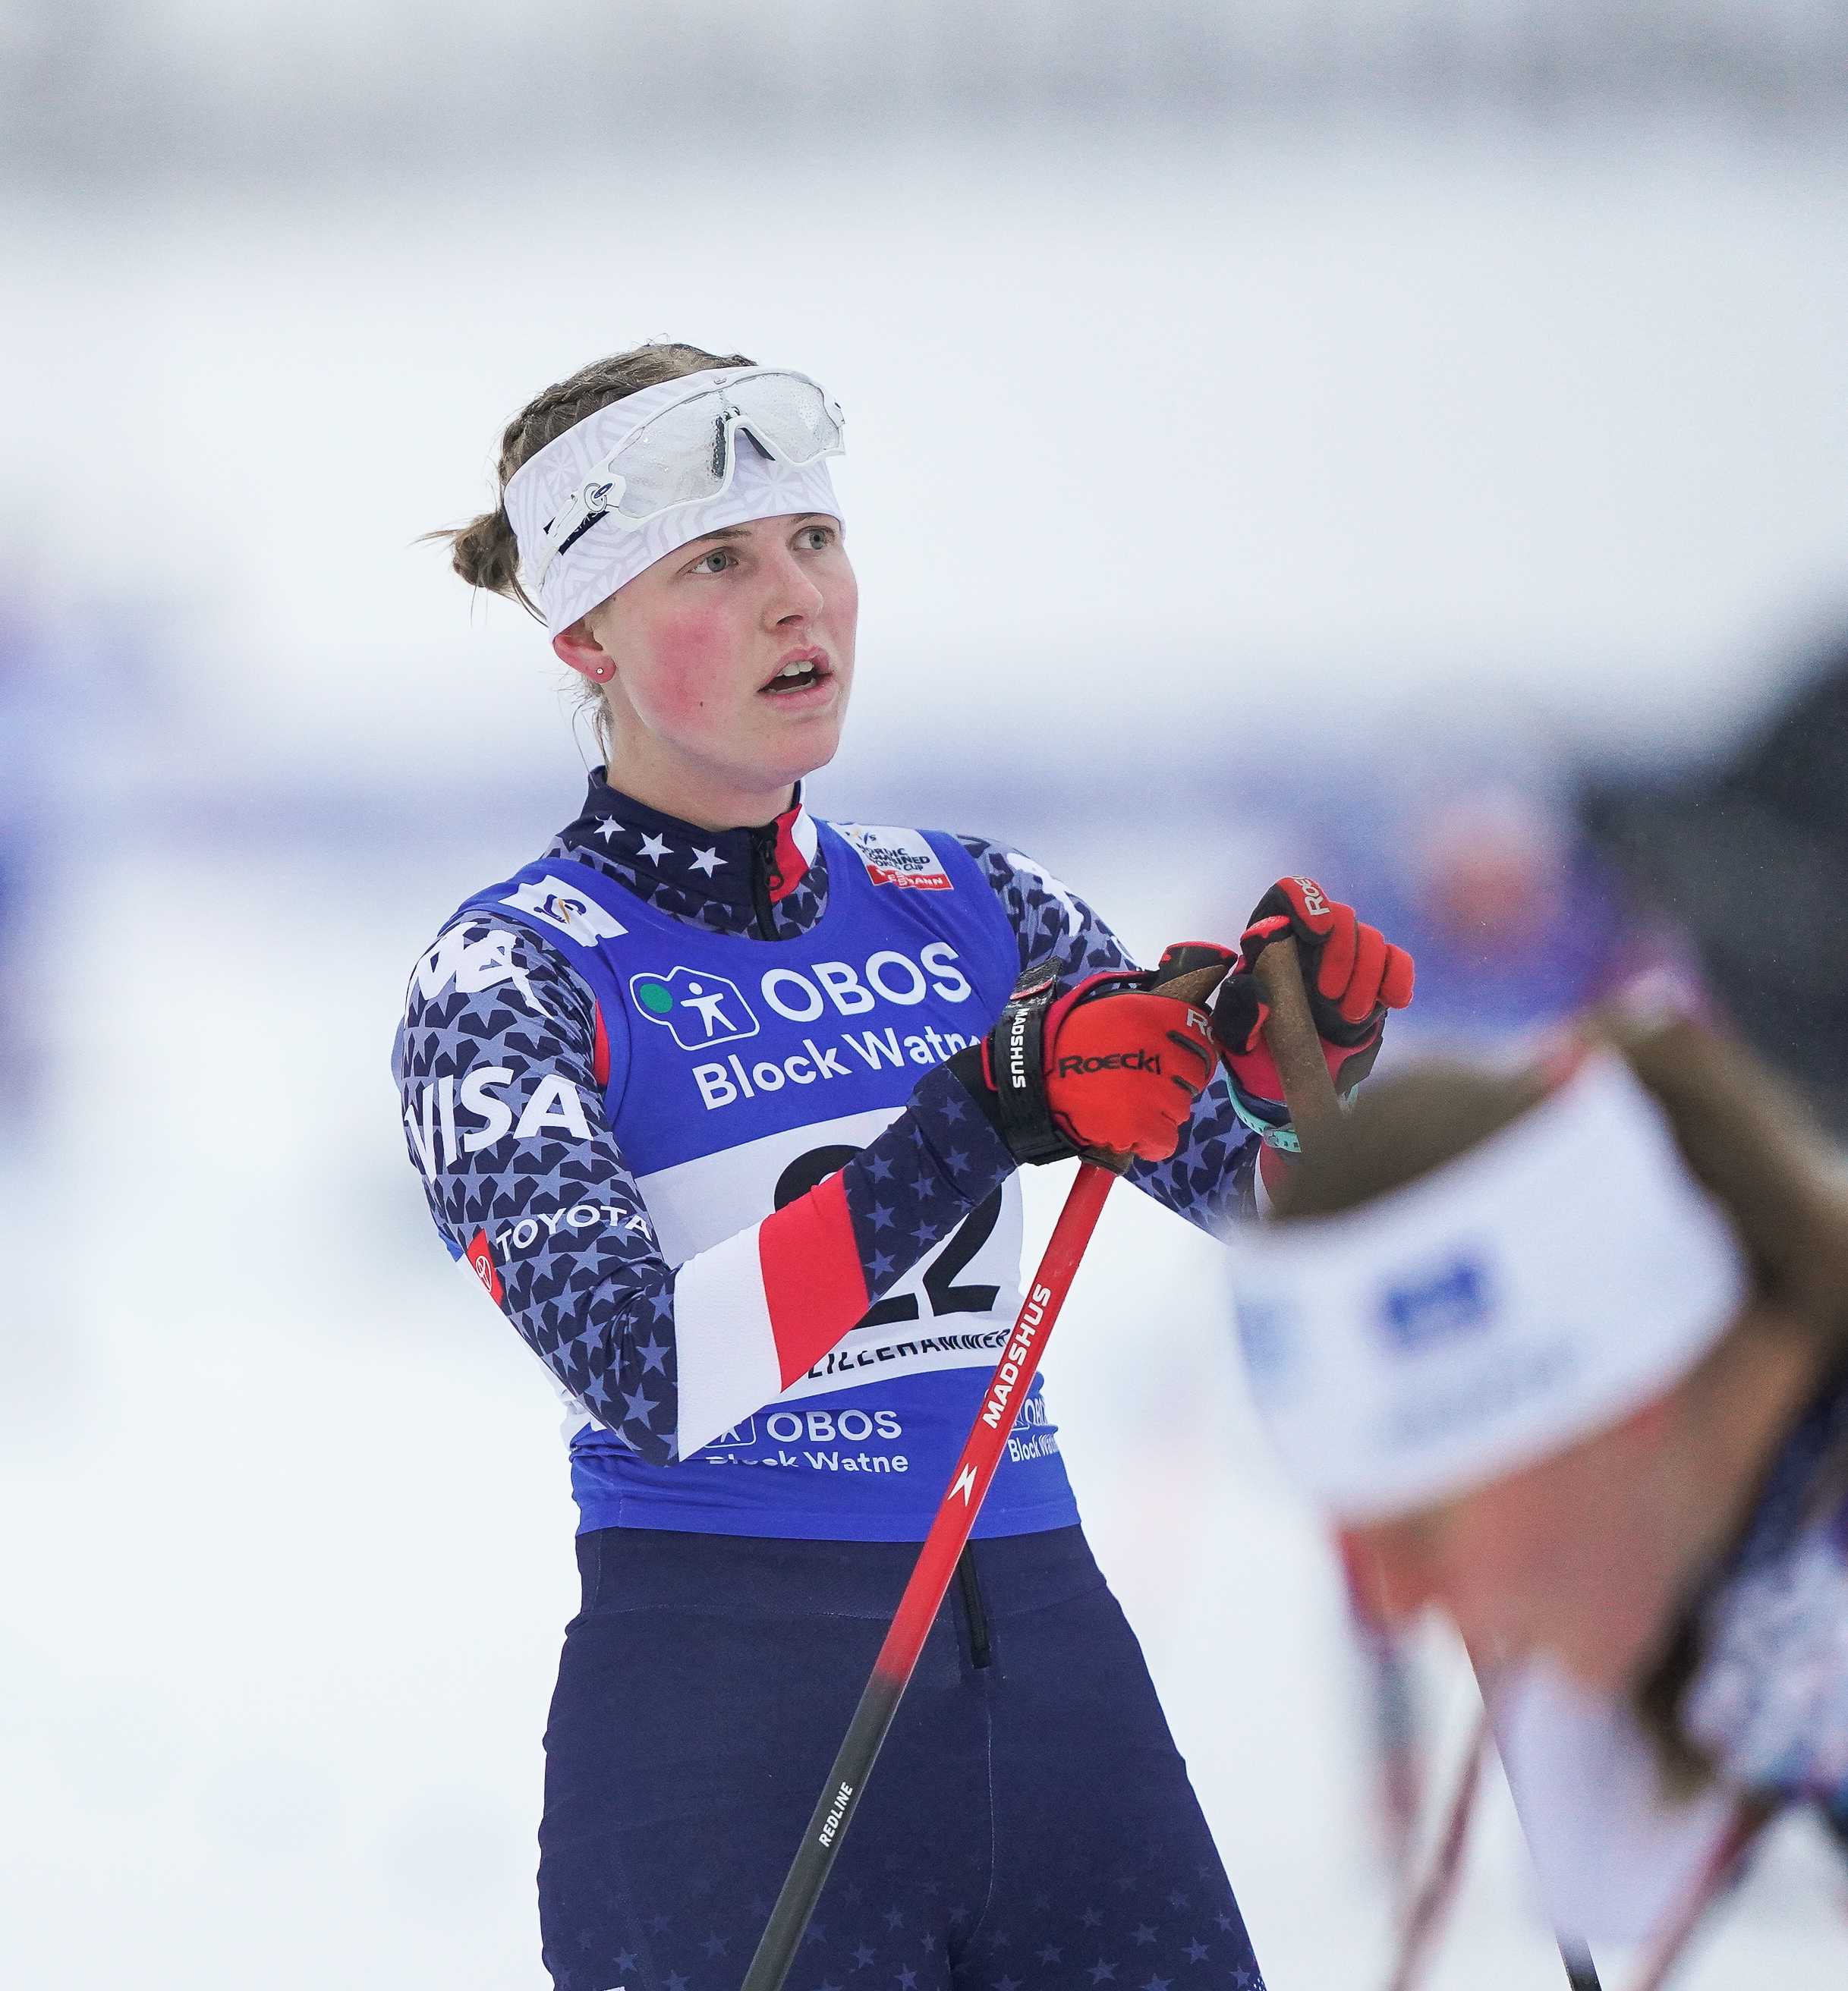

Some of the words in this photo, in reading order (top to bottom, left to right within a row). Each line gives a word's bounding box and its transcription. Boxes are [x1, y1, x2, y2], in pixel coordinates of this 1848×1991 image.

[761, 942, 972, 1022] OBOS
[692, 1040, 852, 1110] Block
[1010, 1008, 1030, 1088] MADSHUS
[404, 1066, 593, 1184] VISA
[496, 1205, 653, 1262] TOYOTA
[982, 1283, 1052, 1429] MADSHUS
[767, 1409, 902, 1442] OBOS
[1007, 1434, 1041, 1462] Block
[803, 1451, 909, 1473] Watne
[819, 1782, 853, 1848] REDLINE
